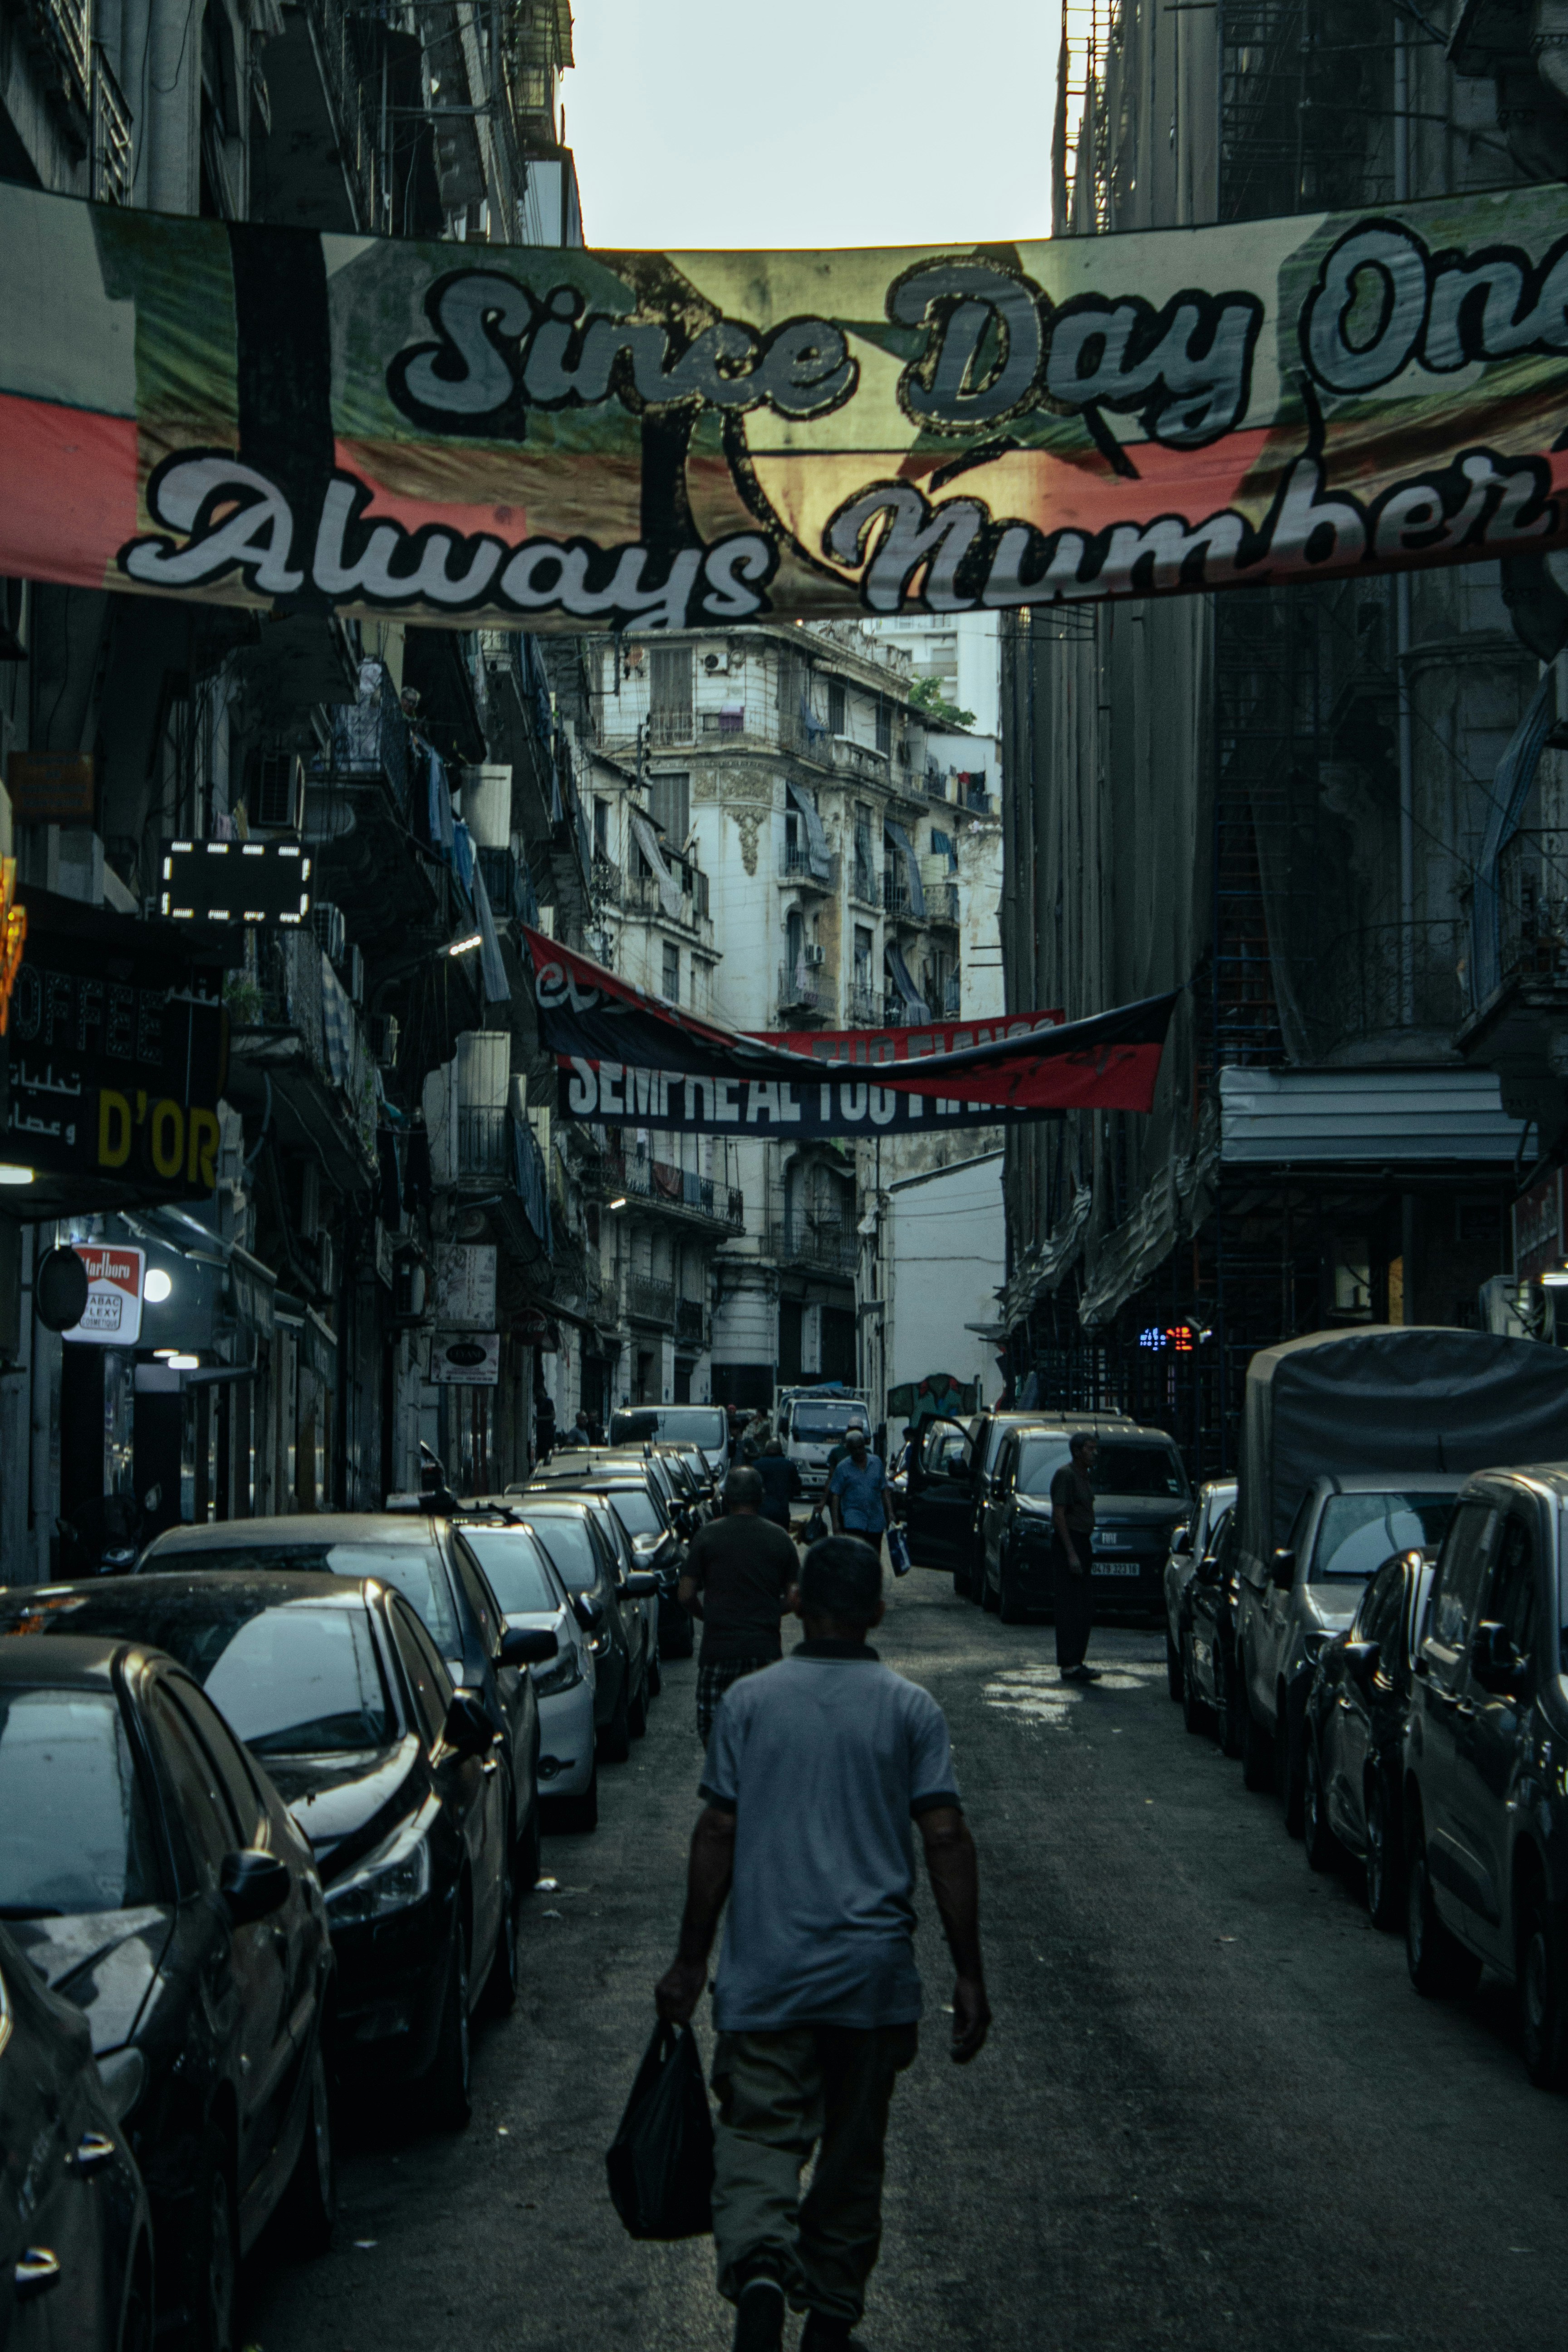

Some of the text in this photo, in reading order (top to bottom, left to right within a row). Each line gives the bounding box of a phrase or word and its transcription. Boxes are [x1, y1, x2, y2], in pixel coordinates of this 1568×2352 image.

[388, 269, 858, 438] Since
[886, 254, 1264, 447] Day
[119, 447, 1559, 632] Always Number
[15, 962, 168, 1066] OFFEE
[98, 1088, 220, 1190] D'OR
[86, 1308, 118, 1317] LEXY
[90, 1295, 119, 1306] ABAC
